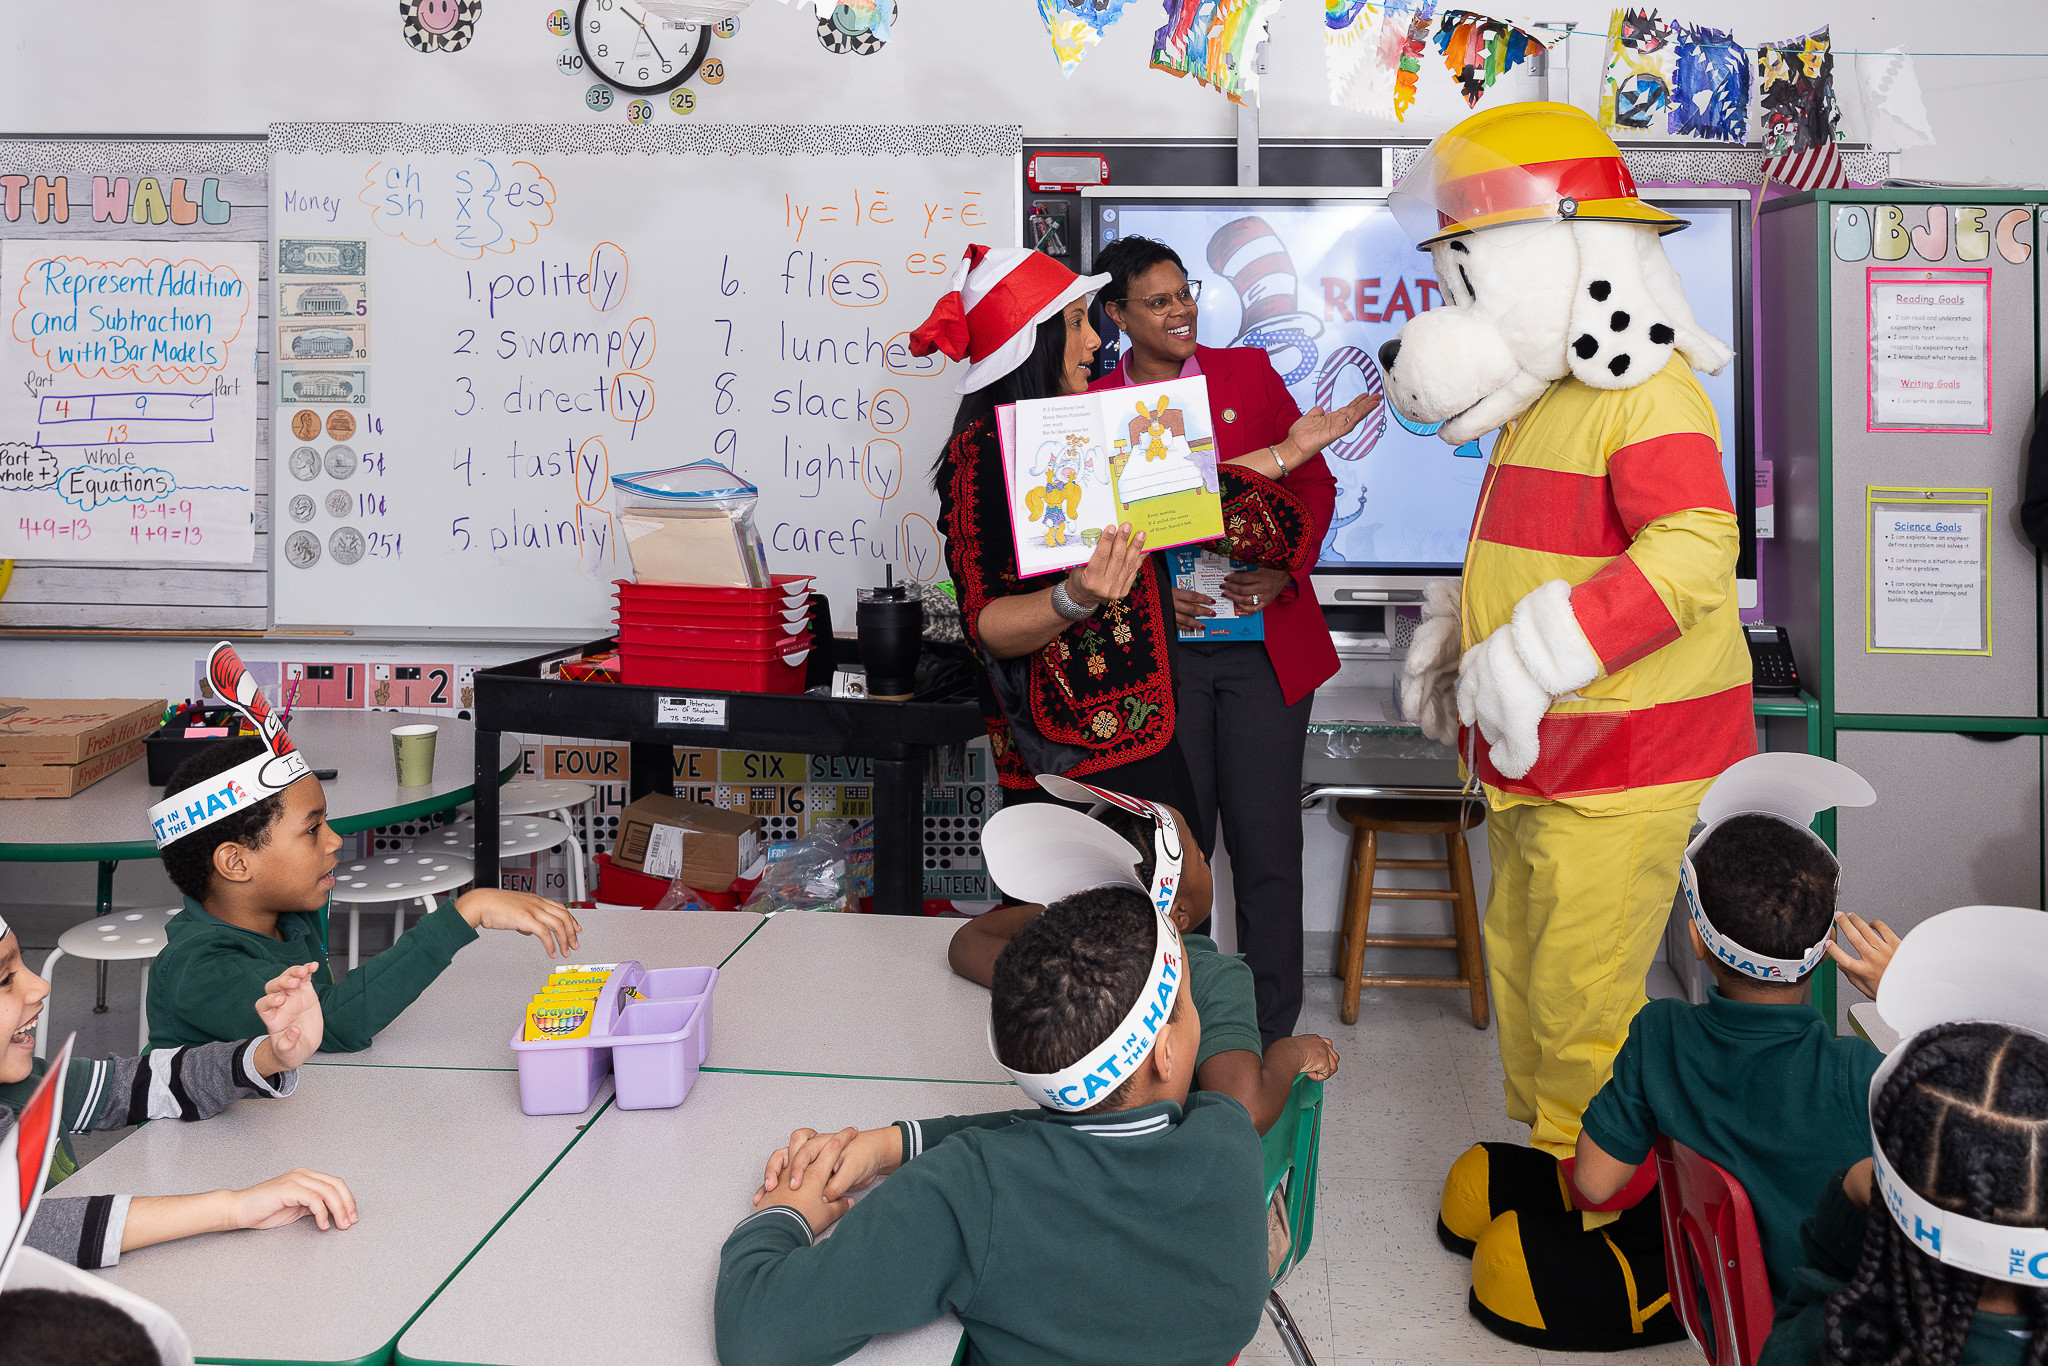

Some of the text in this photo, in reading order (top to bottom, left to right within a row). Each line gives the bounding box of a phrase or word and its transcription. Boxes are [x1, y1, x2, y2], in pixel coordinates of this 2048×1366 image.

[549, 16, 571, 31] :45
[589, 20, 601, 34] 9
[718, 18, 735, 33] :15
[597, 44, 609, 58] 8
[678, 42, 690, 56] 4
[558, 55, 584, 70] :40
[615, 61, 625, 75] 7
[638, 67, 650, 80] 6
[661, 60, 673, 74] 5
[702, 63, 724, 78] :20
[588, 90, 611, 105] :35
[671, 94, 695, 109] :25
[628, 105, 653, 120] :30
[91, 176, 232, 225] WALL
[284, 190, 341, 223] Money
[506, 181, 546, 207] es
[306, 250, 339, 265] ONE
[906, 252, 947, 275] es
[40, 261, 242, 306] Represent Addition
[488, 250, 618, 318] politely
[720, 250, 881, 300] 6. flies
[355, 299, 368, 317] 5
[1896, 294, 1965, 306] Reading Goals
[31, 304, 212, 335] and Subtraction
[58, 335, 218, 365] with Bar Models
[453, 328, 645, 369] 2. swampy
[714, 318, 744, 357] 7.
[355, 348, 367, 359] 10
[27, 370, 55, 388] Part
[214, 374, 241, 396] Part
[1900, 379, 1961, 390] Writing Goals
[55, 400, 70, 418] 4
[135, 395, 148, 416] 9
[353, 394, 366, 405] 20
[455, 375, 646, 441] 3. directly
[714, 371, 895, 425] 8. slacks
[107, 424, 129, 443] 13
[0, 450, 30, 466] Part
[453, 437, 599, 501] 4. tasty
[70, 470, 168, 505] Equations
[784, 434, 892, 518] lightly
[452, 504, 607, 560] 5. plainly
[1894, 521, 1962, 532] Science Goals
[773, 518, 928, 583] carefully
[428, 669, 449, 704] 2
[85, 713, 164, 756] Fresh Hot Pizza
[77, 742, 146, 787] Fresh Hot Pizza
[554, 749, 619, 775] FOUR
[743, 753, 786, 779] SIX
[811, 754, 875, 778] SEVE
[185, 787, 239, 826] HAT
[599, 784, 627, 813] 14
[779, 786, 806, 814] 16
[958, 786, 986, 815] 18
[167, 810, 180, 824] IN
[168, 820, 188, 837] THE
[1155, 884, 1173, 912] AT
[1680, 867, 1702, 922] CAT
[1702, 924, 1713, 940] IN
[1718, 945, 1773, 978] HAT
[536, 1005, 584, 1019] Crayola
[1043, 962, 1179, 1109] THE CAT IN THE HAT
[1885, 1183, 1909, 1230] IN THE
[2009, 1248, 2026, 1275] THE
